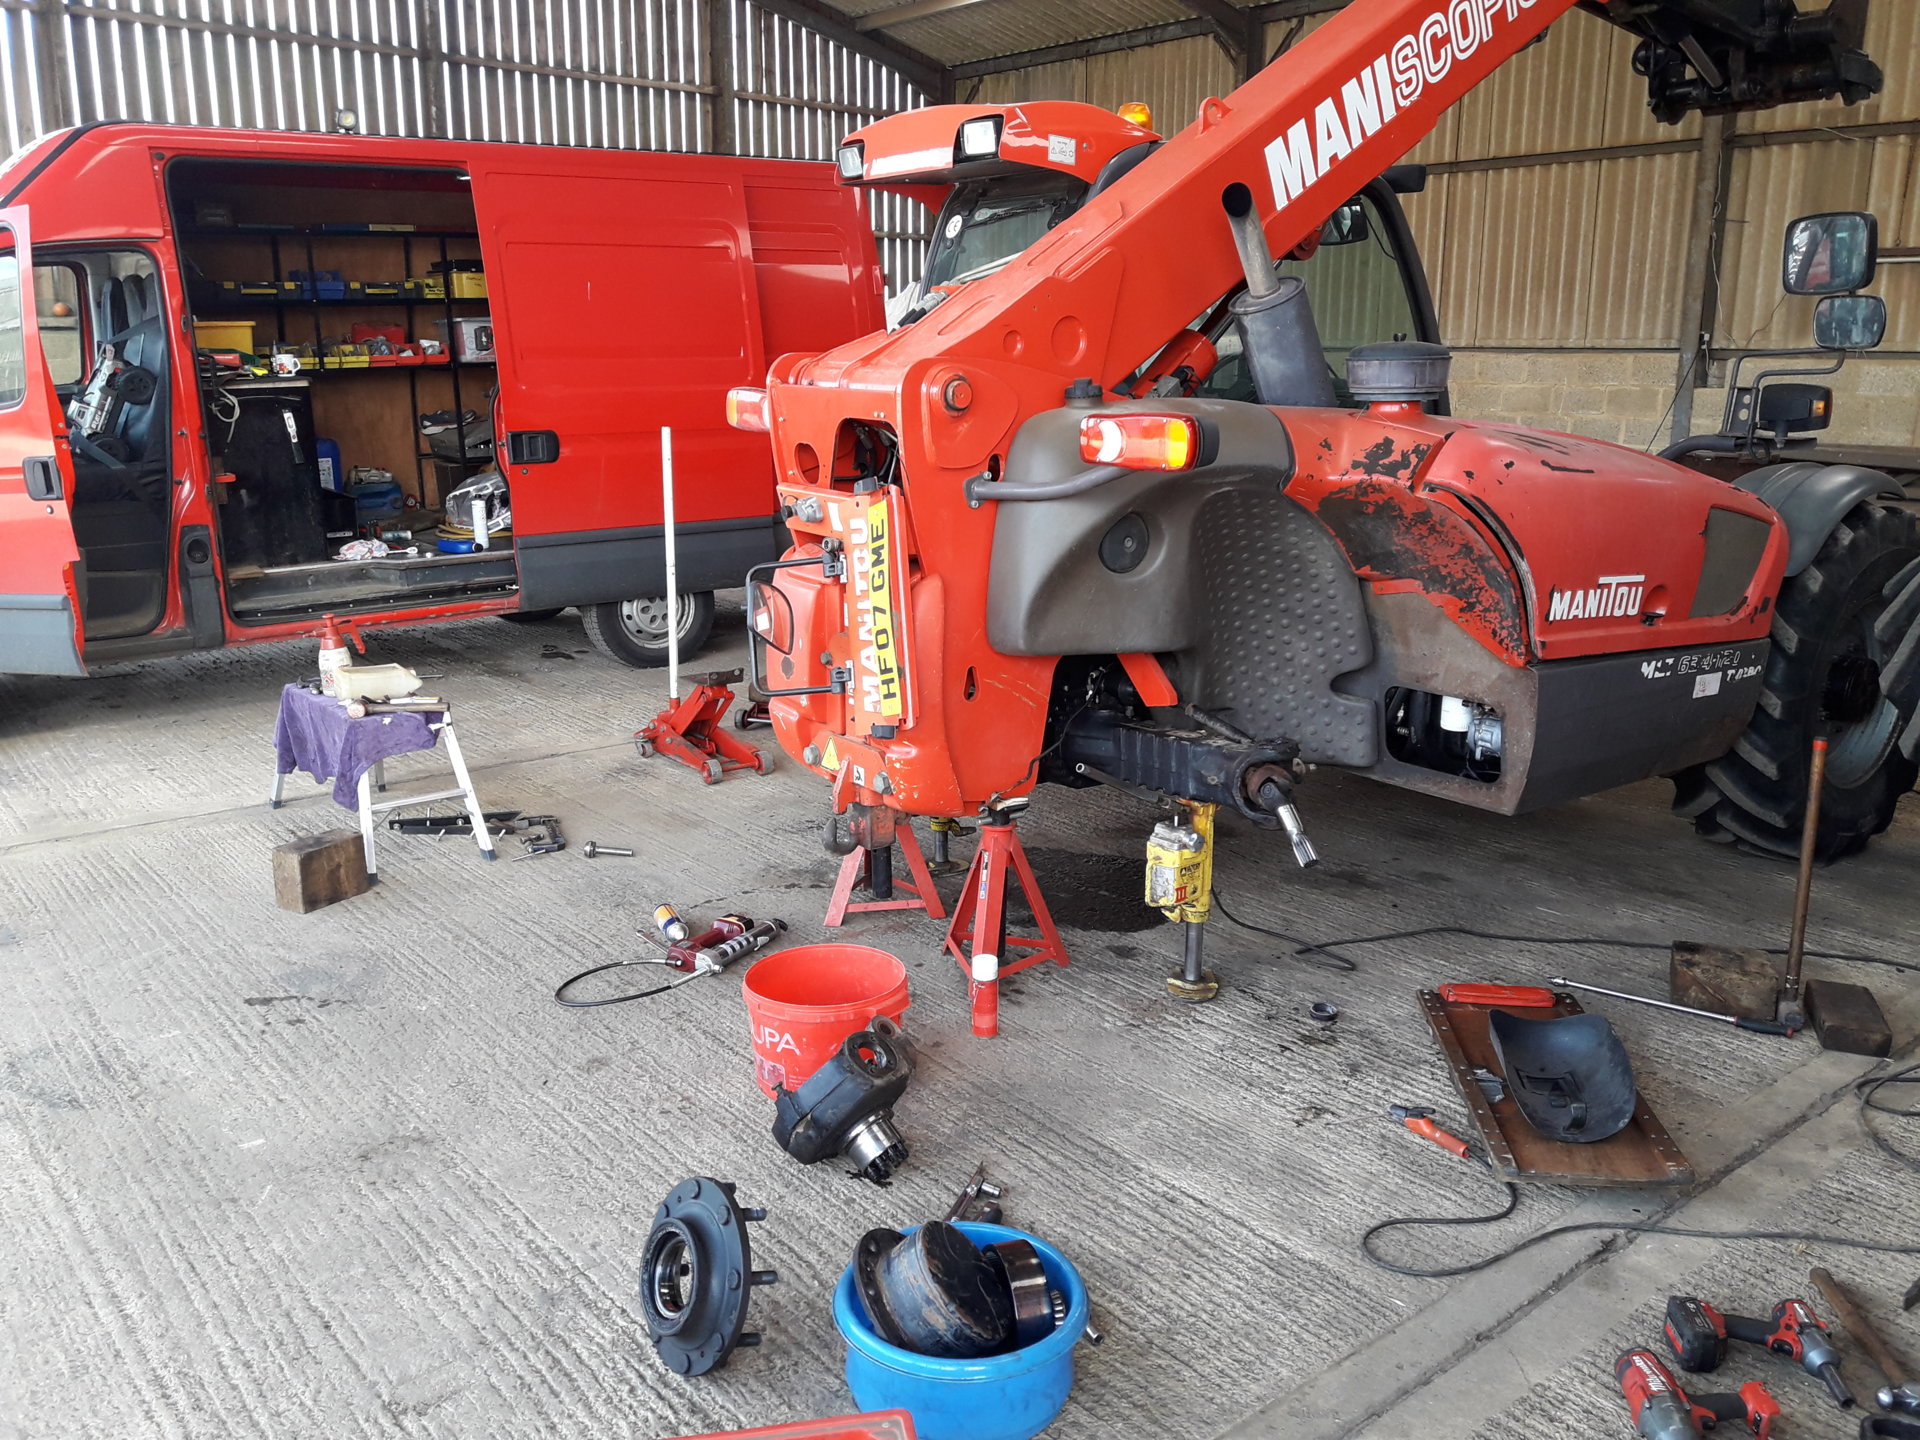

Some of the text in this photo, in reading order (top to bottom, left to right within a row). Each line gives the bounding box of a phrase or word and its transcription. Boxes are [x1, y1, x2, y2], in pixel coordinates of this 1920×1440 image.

[1264, 0, 1540, 211] MANISCOP
[871, 518, 897, 700] HF07 GME
[1549, 575, 1645, 621] MANITOU
